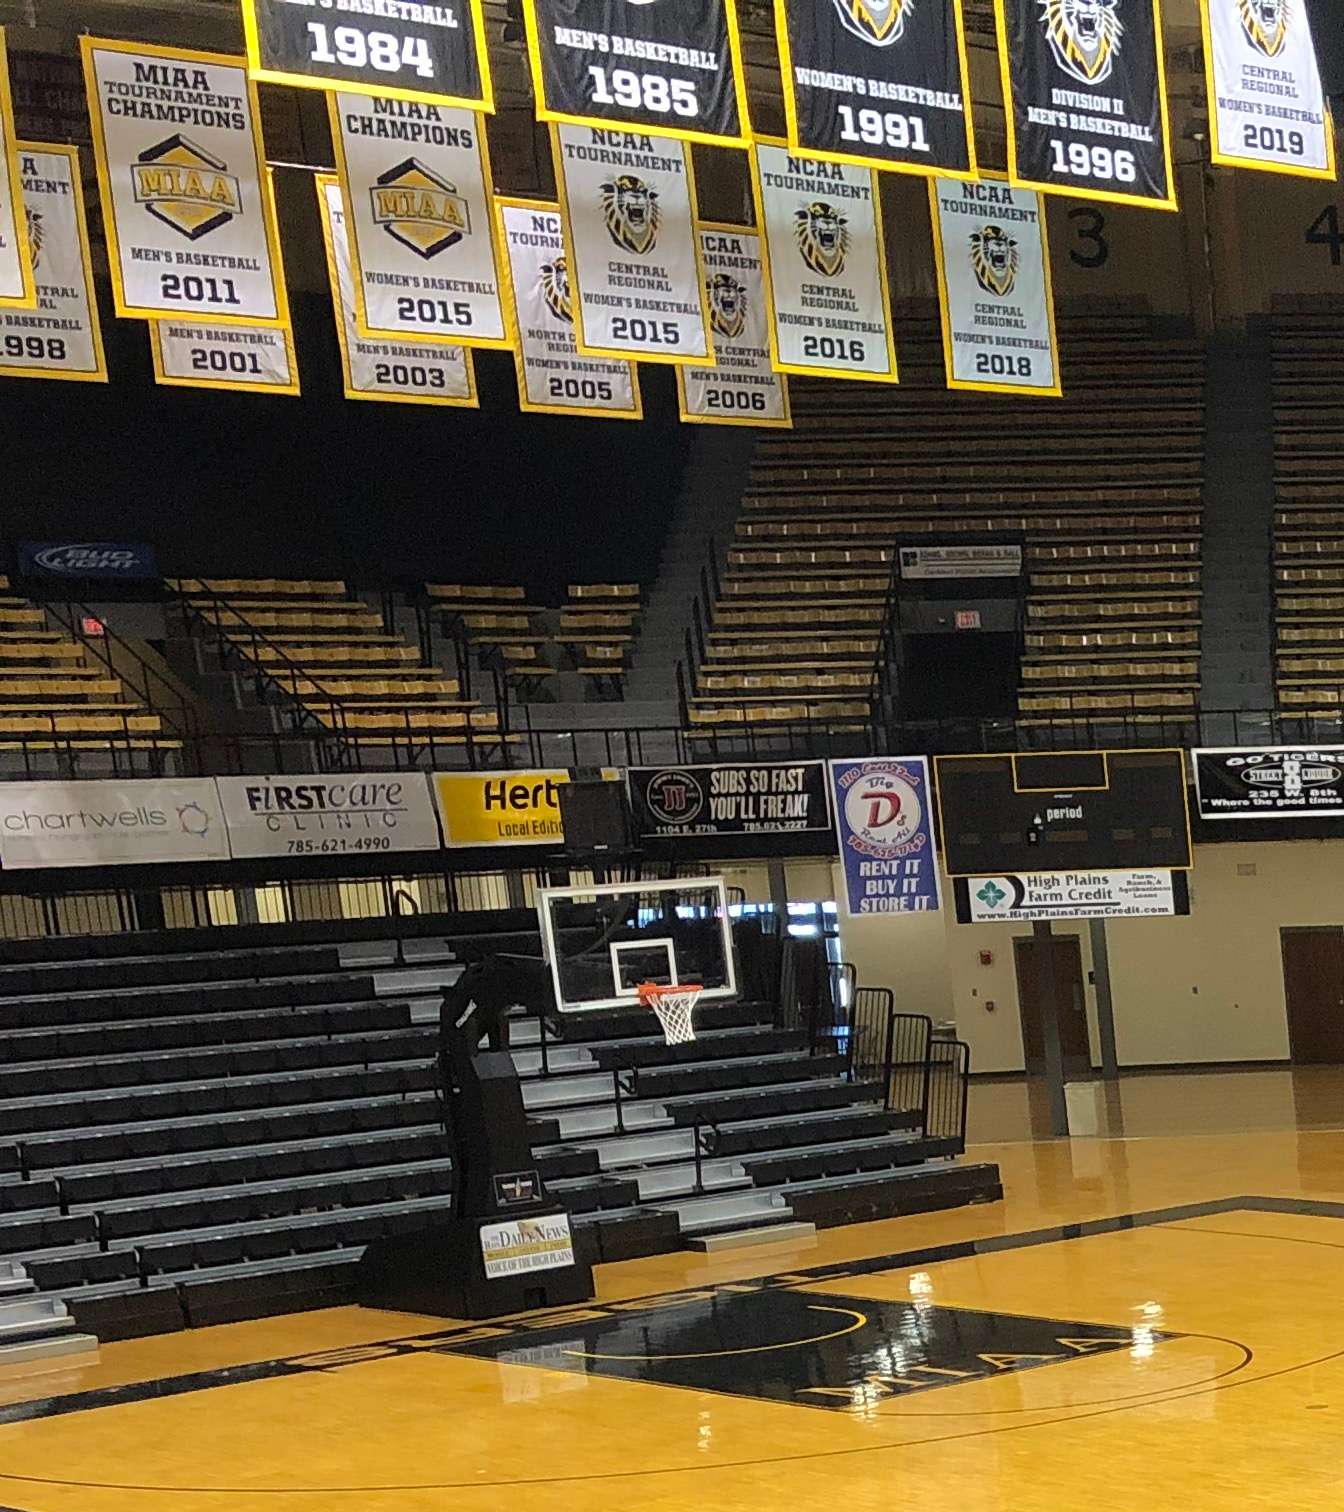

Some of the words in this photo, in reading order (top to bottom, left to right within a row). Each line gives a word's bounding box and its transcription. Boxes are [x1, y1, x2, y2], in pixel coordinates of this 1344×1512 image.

[307, 22, 434, 78] 1984
[554, 25, 608, 53] MEN'S
[612, 36, 718, 70] BASKETBALL
[133, 62, 210, 91] MIAA
[1241, 64, 1296, 83] CENTRAL
[104, 80, 243, 110] TOURNAMENT
[588, 66, 698, 117] 1985
[795, 67, 866, 95] WOMEN'S
[868, 80, 962, 111] BASKETBALL
[1051, 88, 1112, 113] DIVISION
[1241, 79, 1300, 99] REGIONAL
[108, 98, 246, 130] CHAMPIONS
[373, 97, 442, 122] MIAA
[1218, 97, 1263, 115] WOMEN'S
[1264, 104, 1324, 125] BASKETBALL
[347, 115, 473, 149] CHAMPIONS
[838, 105, 930, 151] 1991
[1027, 106, 1067, 129] MEN'S
[1069, 113, 1153, 142] BASKETBALL
[592, 128, 654, 152] NCAA
[1243, 123, 1304, 156] 2019
[565, 144, 682, 173] TOURNAMENT
[787, 156, 845, 181] NCAA
[1050, 139, 1136, 183] 1996
[138, 168, 236, 205] MIAA
[764, 173, 870, 201] TOURNAMENT
[962, 183, 1014, 204] NCAA
[376, 190, 466, 227] MIAA
[941, 199, 1036, 223] TOURNAMENT
[1068, 207, 1108, 268] 3
[1305, 204, 1344, 267] 4
[131, 247, 171, 264] MEN'S
[175, 252, 261, 271] BASKETBALL
[608, 262, 668, 279] CENTRAL
[161, 273, 241, 304] 2011
[365, 271, 420, 288] WOMEN'S
[423, 277, 495, 295] BASKETBALL
[608, 274, 672, 292] REGIONAL
[802, 284, 855, 299] CENTRAL
[398, 298, 473, 325] 2015
[583, 292, 633, 309] WOMEN'S
[636, 298, 700, 316] BASKETBALL
[801, 296, 859, 312] REGIONAL
[975, 303, 1024, 317] CENTRAL
[5, 315, 82, 330] BASKETBALL
[612, 317, 680, 345] 2015
[778, 313, 823, 328] WOMEN'S
[825, 318, 884, 334] BASKETBALL
[974, 315, 1027, 329] REGIONAL
[168, 327, 203, 341] MEN'S
[206, 330, 277, 346] BASKETBALL
[528, 330, 565, 341] NORTH
[954, 332, 994, 345] WOMEN'S
[995, 336, 1049, 350] BASKETBALL
[191, 348, 262, 374] 2001
[356, 343, 389, 355] MEN'S
[391, 345, 457, 361] BASKETBALL
[803, 336, 865, 362] 2016
[376, 364, 445, 388] 2003
[526, 357, 569, 370] WOMEN'S
[571, 361, 628, 376] BASKETBALL
[976, 353, 1031, 377] 2018
[550, 378, 613, 401] 2005
[706, 390, 766, 410] 2006
[710, 770, 746, 795] SUBS
[750, 769, 768, 794] SO
[771, 768, 805, 793] FAST
[708, 795, 757, 821] YOU'LL
[759, 794, 808, 819] FREAK!
[1211, 798, 1250, 807] Where
[1252, 797, 1274, 806] the
[1277, 797, 1308, 807] good
[1309, 796, 1343, 805] times
[4, 806, 167, 831] chartwells
[1047, 806, 1082, 822] period
[498, 819, 529, 837] Local
[287, 837, 391, 854] 785-621-4990
[860, 860, 899, 877] RENT
[905, 859, 921, 875] IT
[866, 880, 897, 895] BUY
[903, 878, 920, 893] IT
[1027, 875, 1060, 889] High
[1066, 874, 1109, 887] Plains
[860, 896, 910, 913] STORE
[915, 896, 930, 911] IT
[1028, 890, 1063, 902] Farm
[1068, 887, 1113, 900] Credit
[977, 906, 1168, 920] www.HighPlainsFarmCredit.com
[499, 1230, 536, 1248] DAILY
[535, 1224, 568, 1241] NEWS
